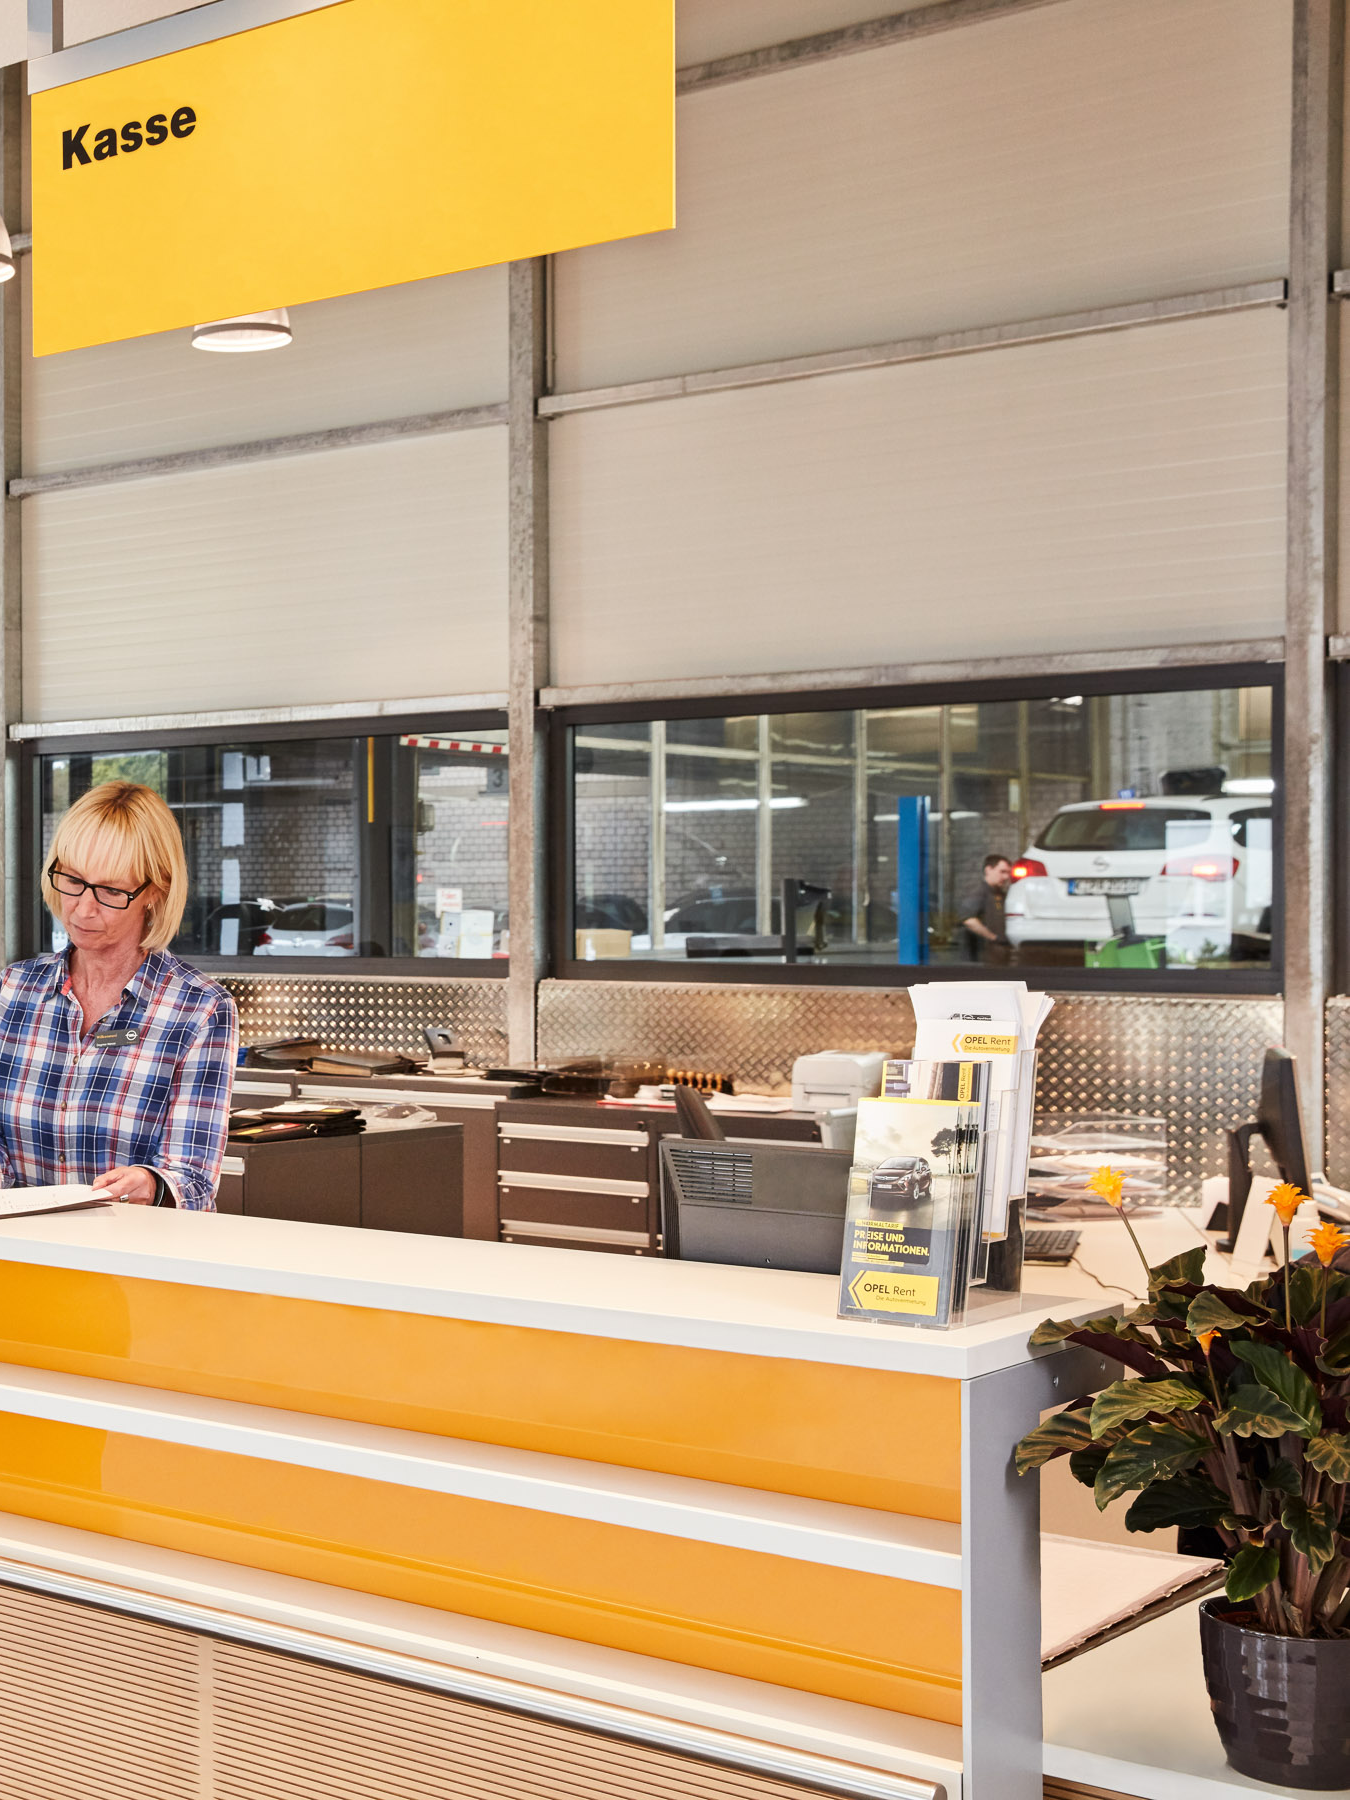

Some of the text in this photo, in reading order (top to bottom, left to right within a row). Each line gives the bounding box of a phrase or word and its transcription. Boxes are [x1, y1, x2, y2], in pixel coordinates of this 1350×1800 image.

[62, 105, 197, 171] Kasse
[493, 768, 504, 788] 3
[964, 1036, 1011, 1046] OPEL Rent
[854, 1230, 905, 1243] PREISE UND
[853, 1240, 930, 1256] INFORMATIONEN.
[863, 1283, 916, 1297] OPEL Rent
